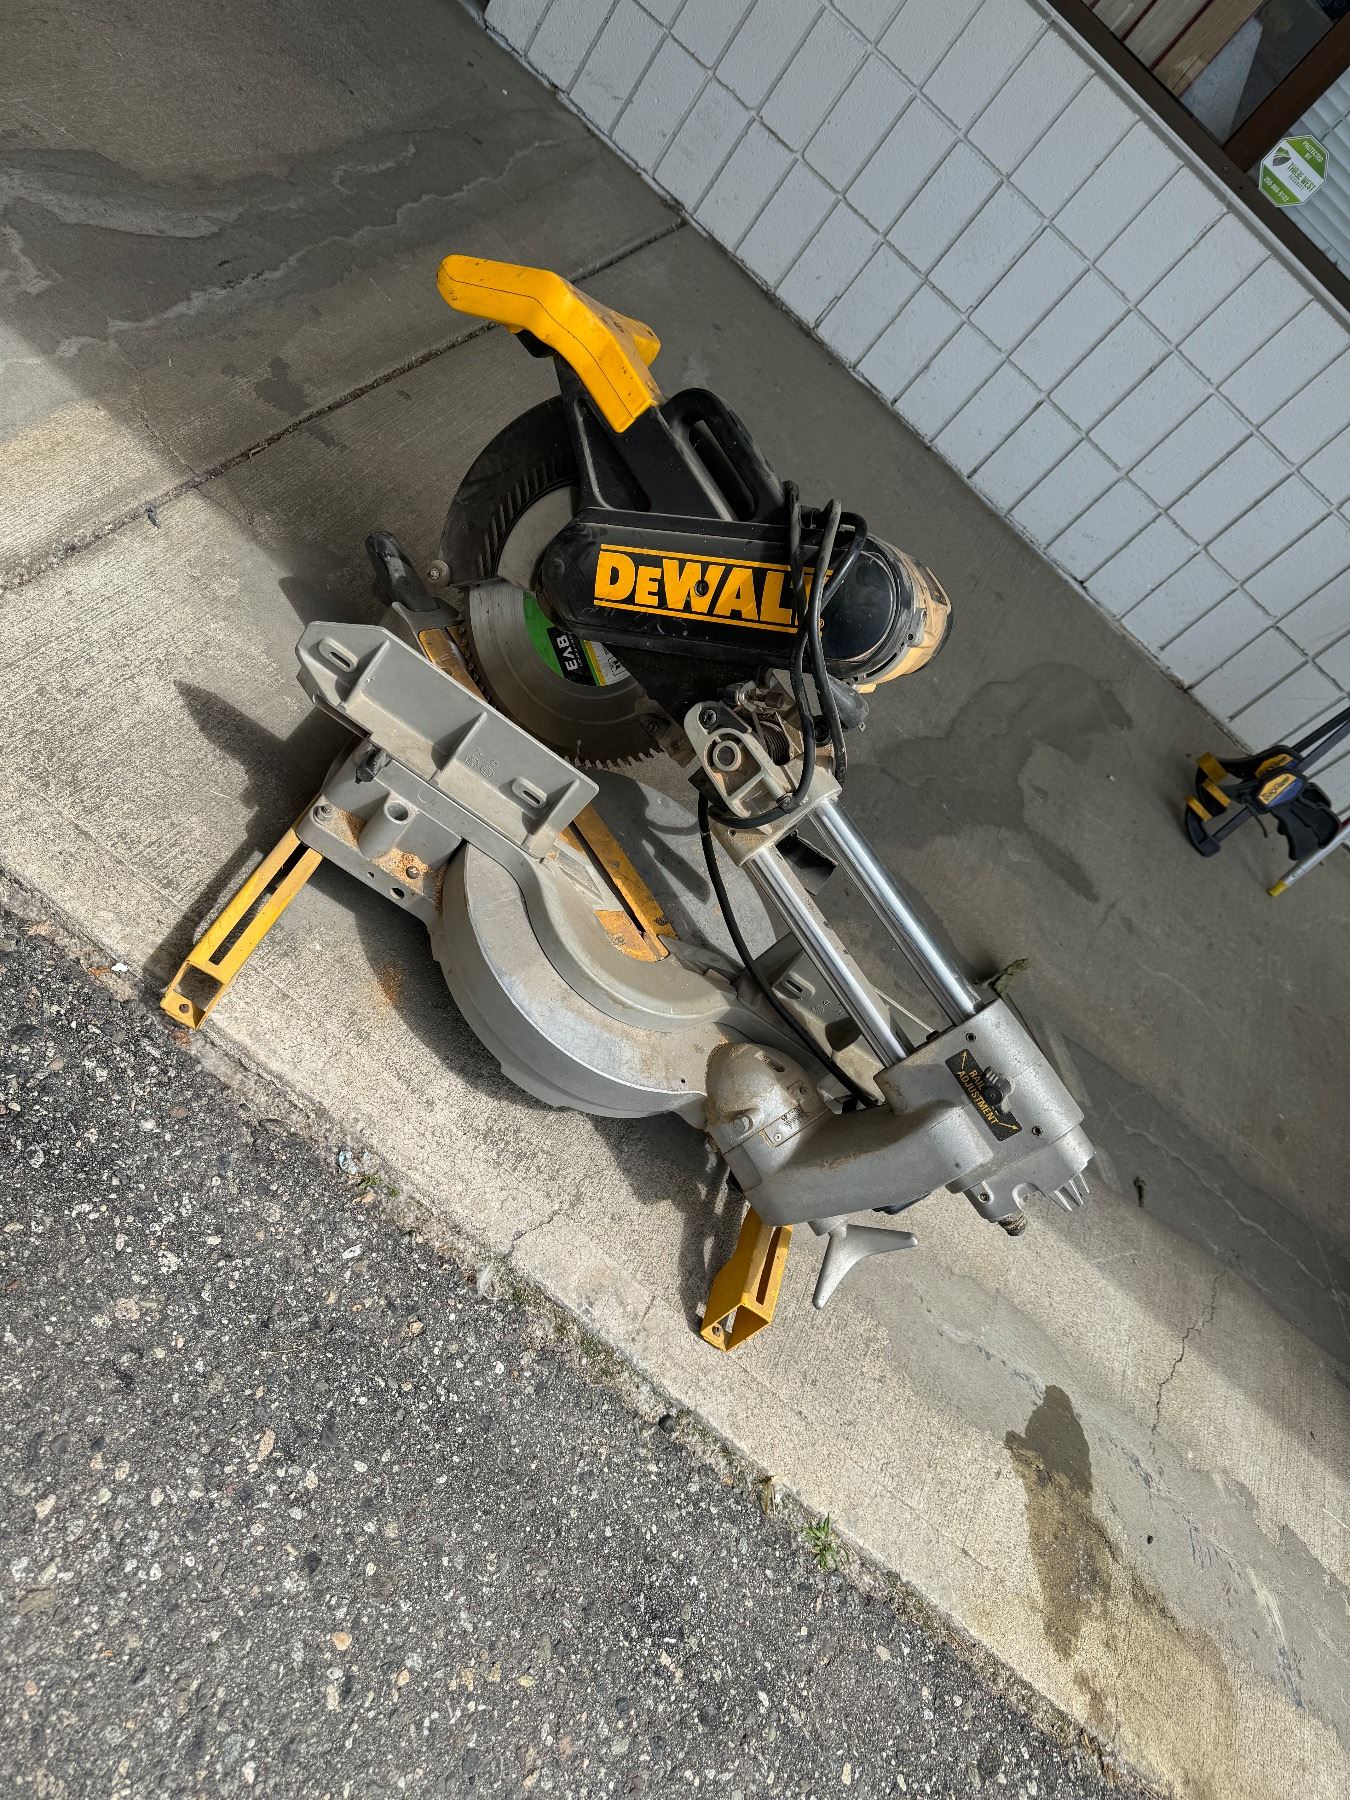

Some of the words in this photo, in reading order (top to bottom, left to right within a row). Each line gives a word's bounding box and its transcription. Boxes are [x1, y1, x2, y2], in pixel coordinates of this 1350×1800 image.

[1302, 140, 1324, 162] PROTECTED
[1301, 173, 1317, 192] WEST
[594, 550, 831, 626] DEWAL
[556, 634, 579, 671] EAB
[968, 1069, 986, 1090] RAIL
[956, 1070, 1000, 1125] ADJUSTMENT
